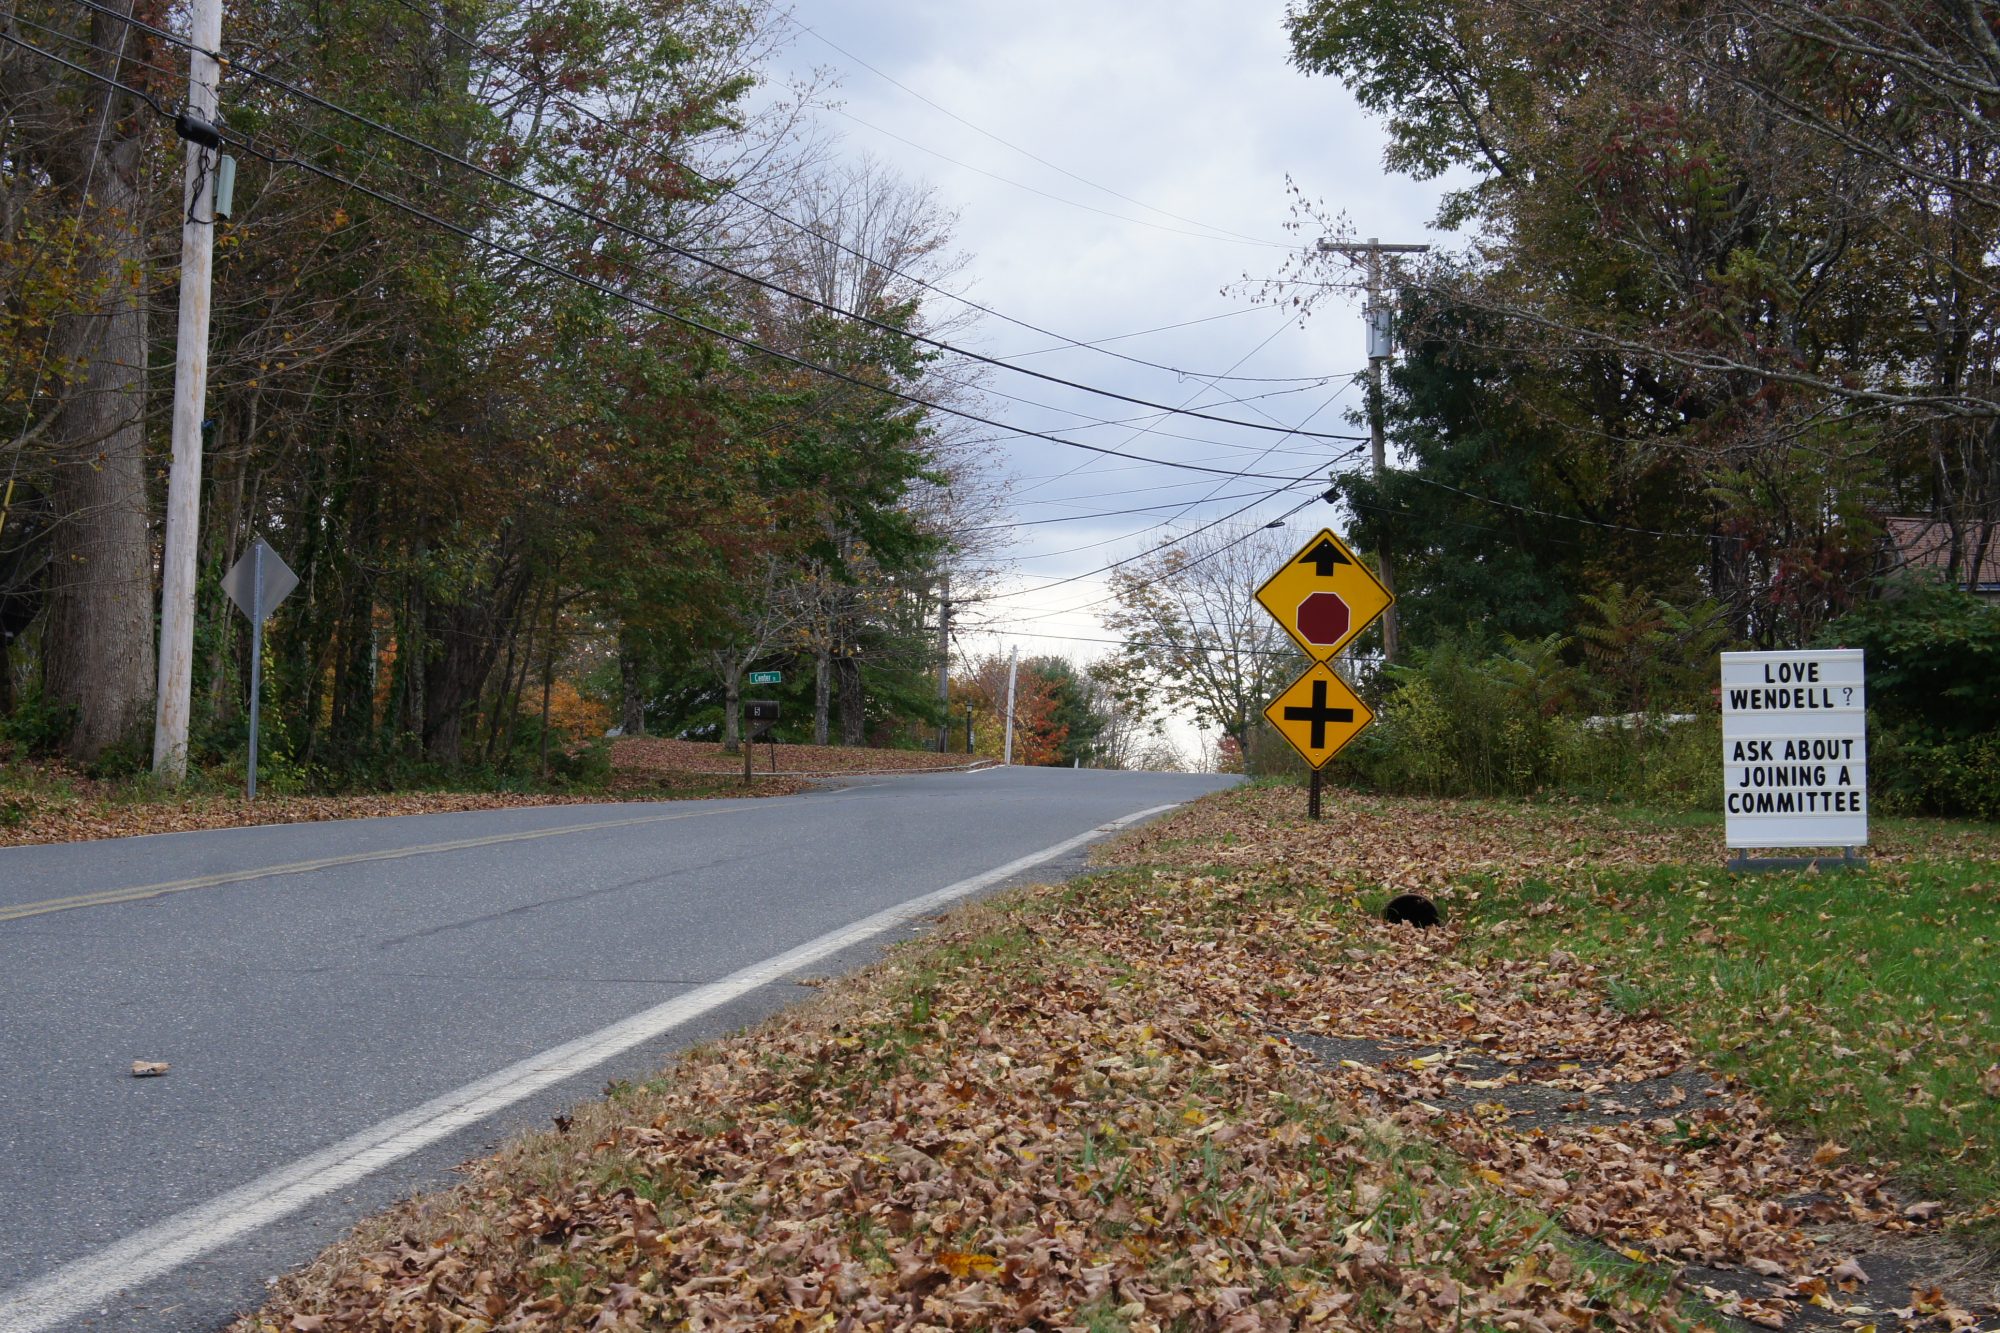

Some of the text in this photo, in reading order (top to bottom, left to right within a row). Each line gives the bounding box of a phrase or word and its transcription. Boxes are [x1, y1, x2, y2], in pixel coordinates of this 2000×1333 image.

[754, 673, 771, 682] Center
[1764, 662, 1819, 684] LOVE
[754, 706, 760, 716] 5
[1733, 739, 1854, 761] ASK ABOUT
[1739, 765, 1851, 788] JOINING A
[1728, 791, 1861, 814] COMMITTEE
